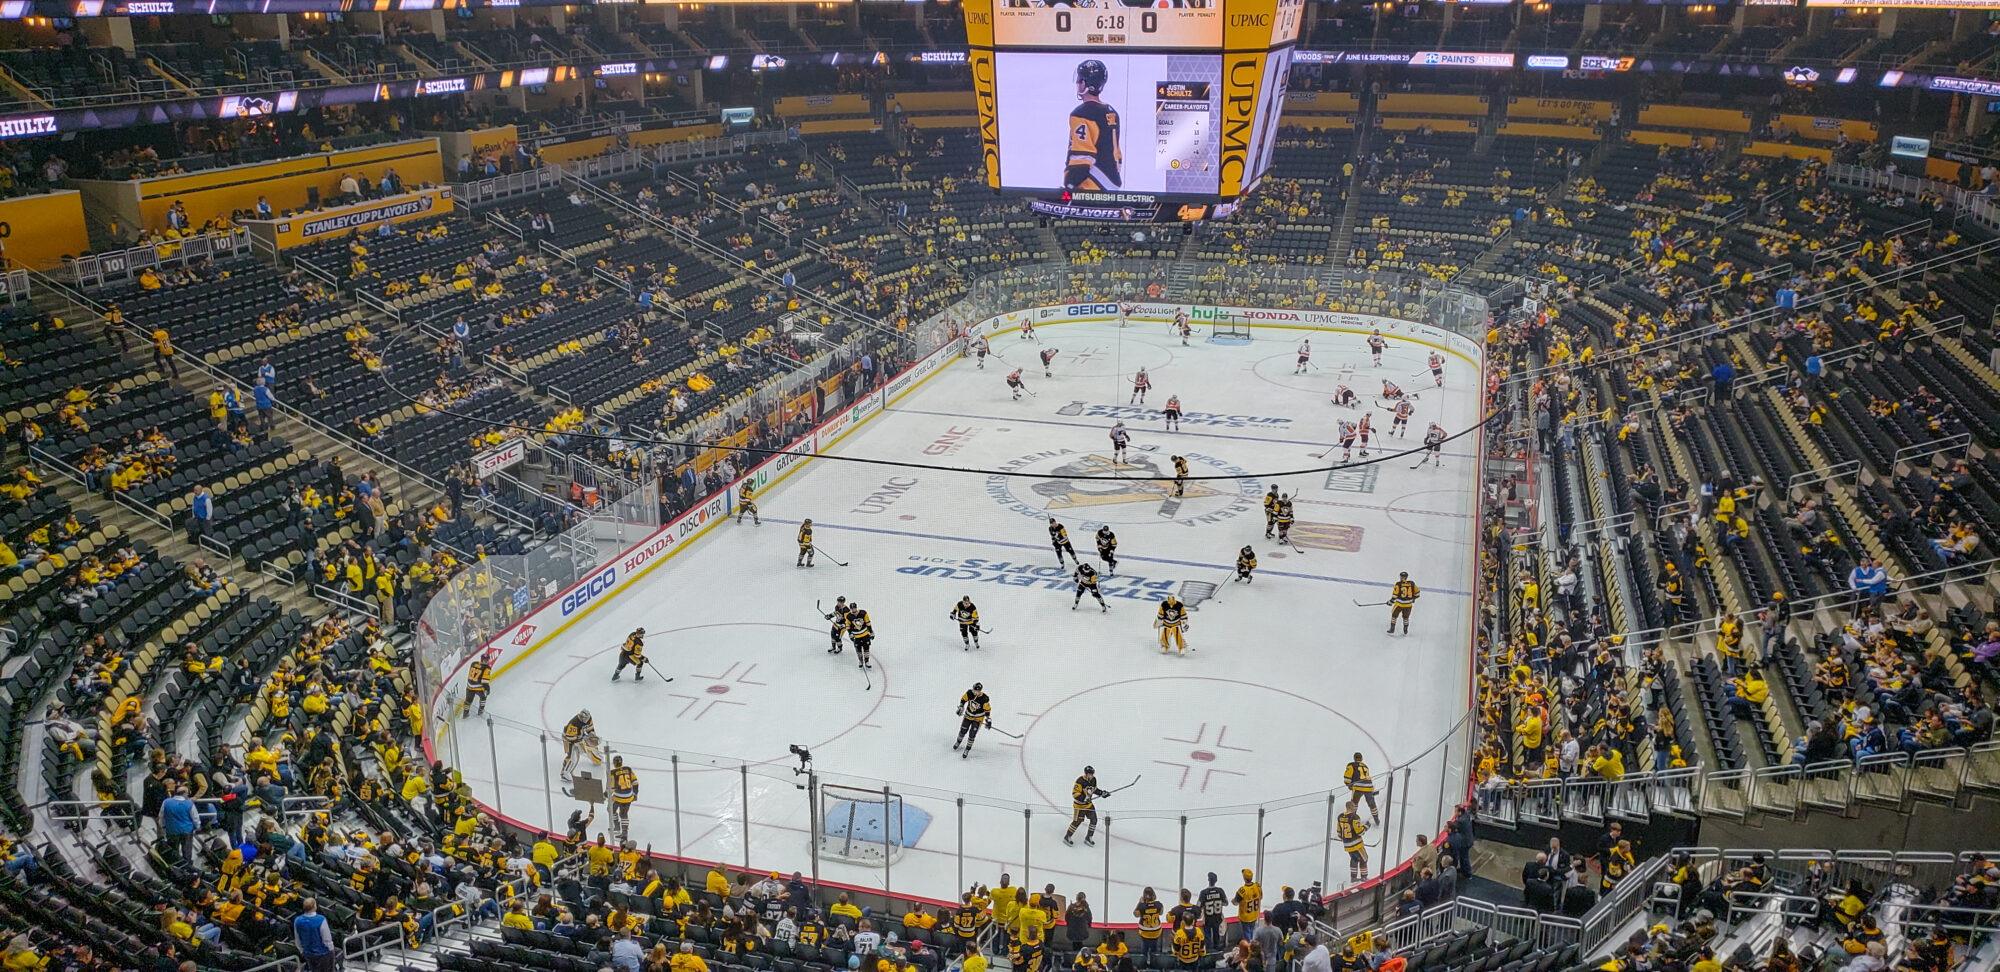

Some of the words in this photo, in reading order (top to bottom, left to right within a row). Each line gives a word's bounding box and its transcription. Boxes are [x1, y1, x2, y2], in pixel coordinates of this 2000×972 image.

[129, 2, 174, 13] SCHULTZ
[968, 12, 989, 25] UPMC
[1056, 12, 1071, 32] 0
[1096, 16, 1124, 29] 6:18
[1142, 12, 1157, 33] 0
[1230, 14, 1269, 27] UPMC
[922, 52, 965, 61] SCHULTZ
[1442, 55, 1475, 64] PAINTS
[1477, 56, 1510, 64] ARENA
[601, 63, 636, 75] SCHULTZ
[1582, 60, 1628, 69] SCHULTZ
[380, 84, 390, 100] 4
[425, 79, 465, 94] SCHULTZ
[1933, 78, 1967, 89] STANLEY
[1966, 82, 1981, 92] CUP
[976, 56, 1000, 177] UPMC
[1220, 57, 1257, 184] UPMC
[0, 117, 56, 137] HULTZ
[1076, 124, 1086, 140] 4
[540, 172, 550, 182] 103
[482, 184, 492, 194] 103
[1072, 193, 1116, 202] MITSUBISHI
[1117, 194, 1154, 202] ELECTRIC
[304, 216, 350, 235] STANLEY
[350, 212, 370, 226] CUP
[370, 202, 418, 221] PLAYOFFS
[1054, 205, 1070, 216] CUP
[1070, 208, 1120, 218] PLAYOFFS
[279, 223, 290, 233] 102
[214, 238, 231, 250] 101
[106, 260, 125, 272] 101
[1068, 304, 1118, 316] GEICO
[1134, 304, 1158, 314] Coors
[1192, 306, 1230, 320] hulu
[1243, 311, 1300, 321] HONDA
[1304, 314, 1338, 324] UPMC
[1220, 414, 1293, 424] CUP
[922, 426, 973, 456] GNC
[484, 447, 518, 469] GNC
[776, 441, 810, 471] GATORADE
[998, 448, 1075, 472] ARENA
[850, 476, 919, 514] UPMC
[680, 499, 722, 538] DISCOVER
[624, 534, 675, 574] HONDA
[896, 565, 986, 581] CUP
[561, 567, 616, 616] GEICO
[514, 626, 534, 646] ORKIN
[469, 665, 482, 682] 87
[618, 774, 632, 790] 46
[1204, 902, 1222, 916] 58
[860, 944, 873, 954] 71
[1182, 942, 1200, 956] 66
